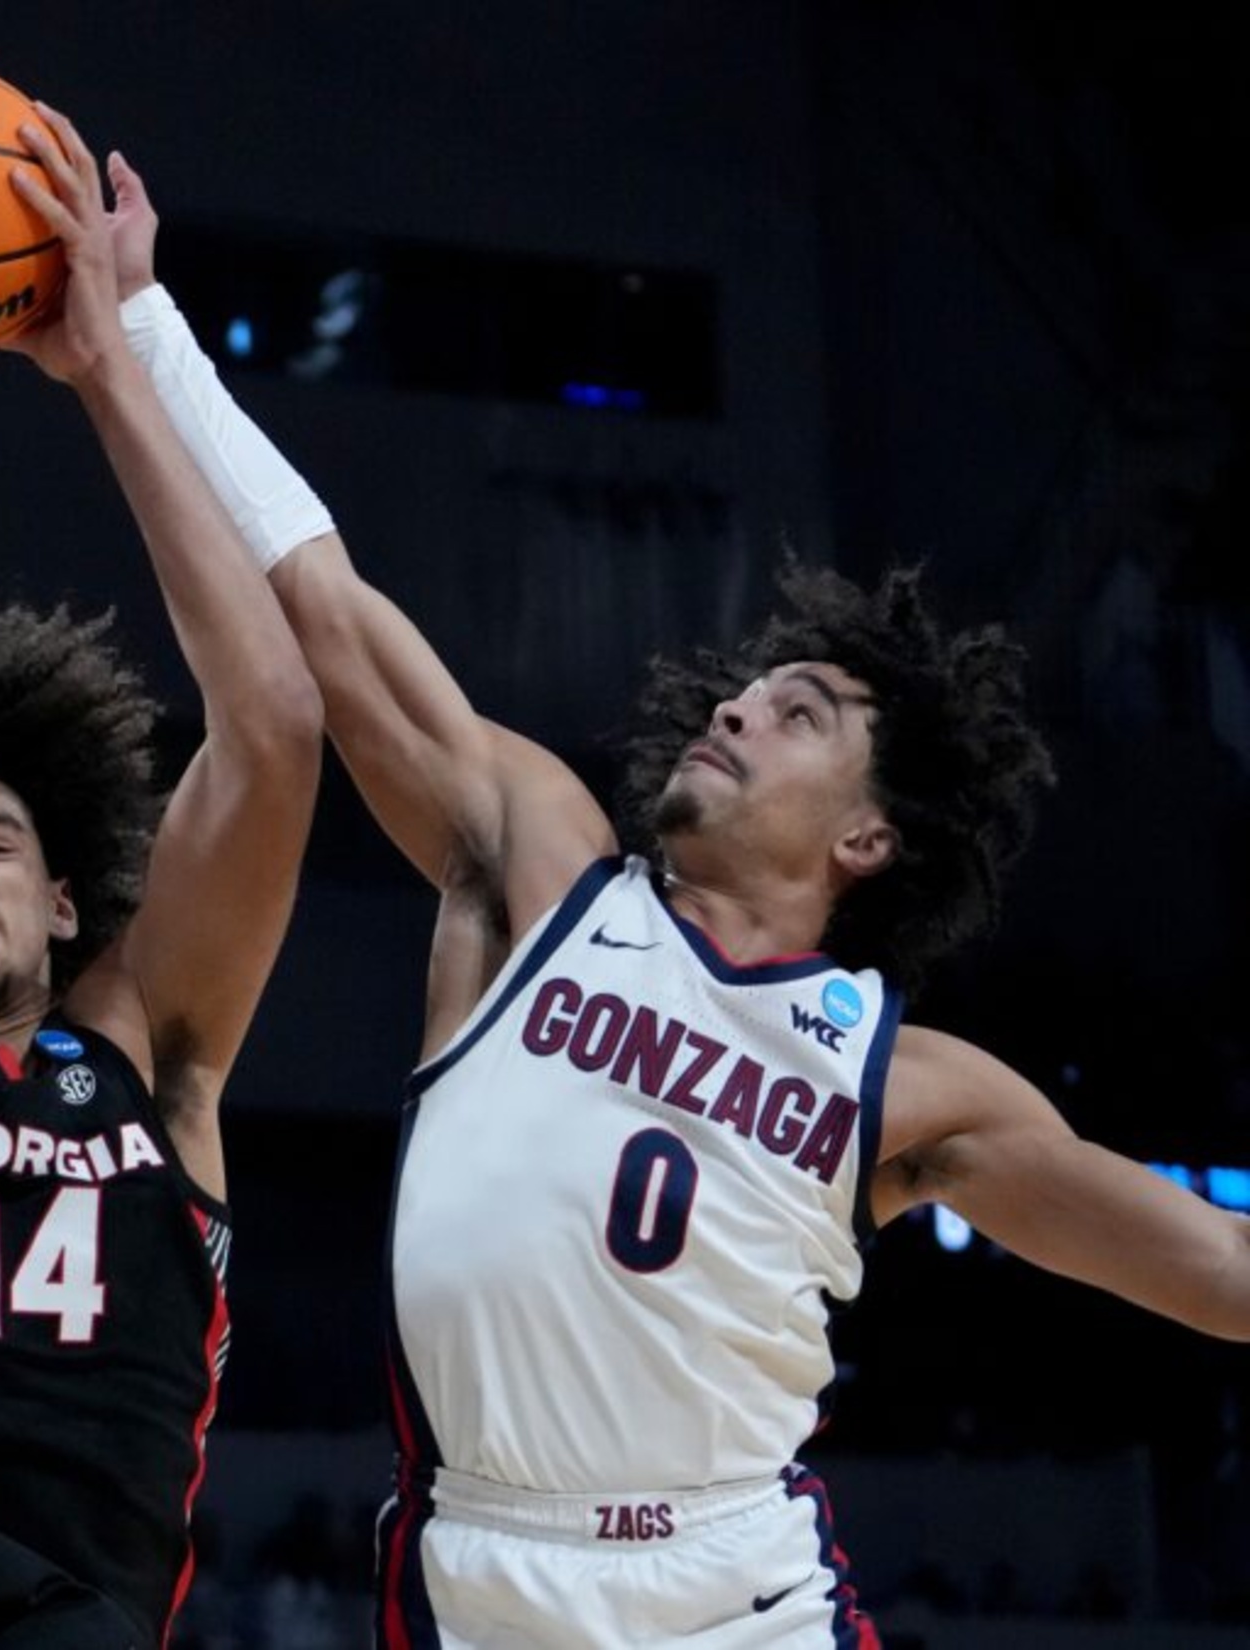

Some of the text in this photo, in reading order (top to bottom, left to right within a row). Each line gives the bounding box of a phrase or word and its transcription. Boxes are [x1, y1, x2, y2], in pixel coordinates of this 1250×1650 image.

[791, 1002, 847, 1054] WCC
[59, 1068, 92, 1101] SEC
[521, 977, 860, 1187] GONZAGA
[605, 1126, 699, 1275] 0
[595, 1503, 674, 1541] ZAGS
